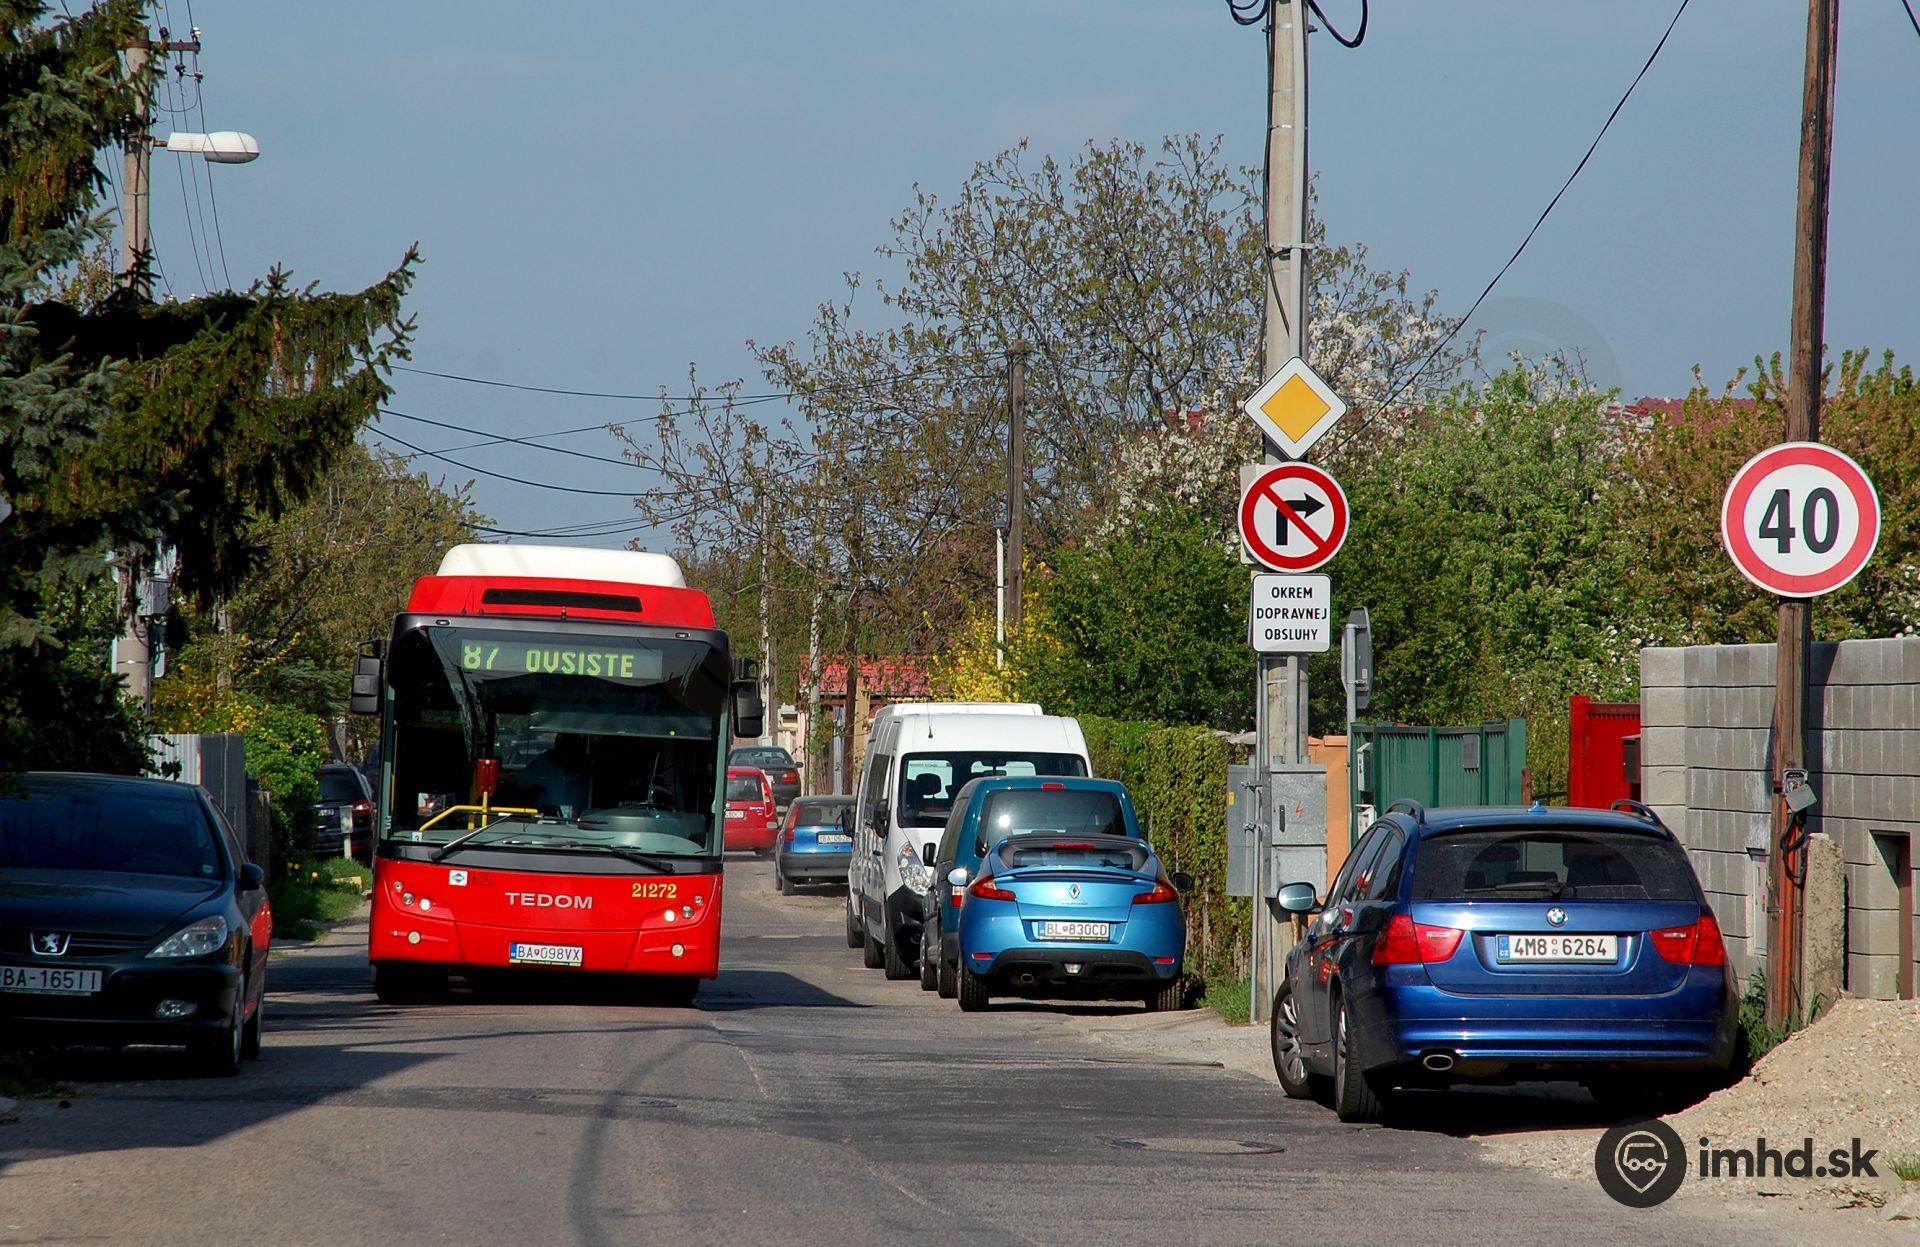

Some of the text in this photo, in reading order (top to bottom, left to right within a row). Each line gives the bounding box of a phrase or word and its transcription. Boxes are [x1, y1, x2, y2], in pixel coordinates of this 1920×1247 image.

[1759, 487, 1840, 554] 40
[1271, 587, 1313, 599] OKREM
[1256, 608, 1327, 620] DOPRAVNEJ
[1264, 628, 1318, 640] OBSLUHY
[631, 883, 677, 898] 21272
[505, 892, 593, 909] TEDOM
[1514, 938, 1607, 956] 4M8 6264
